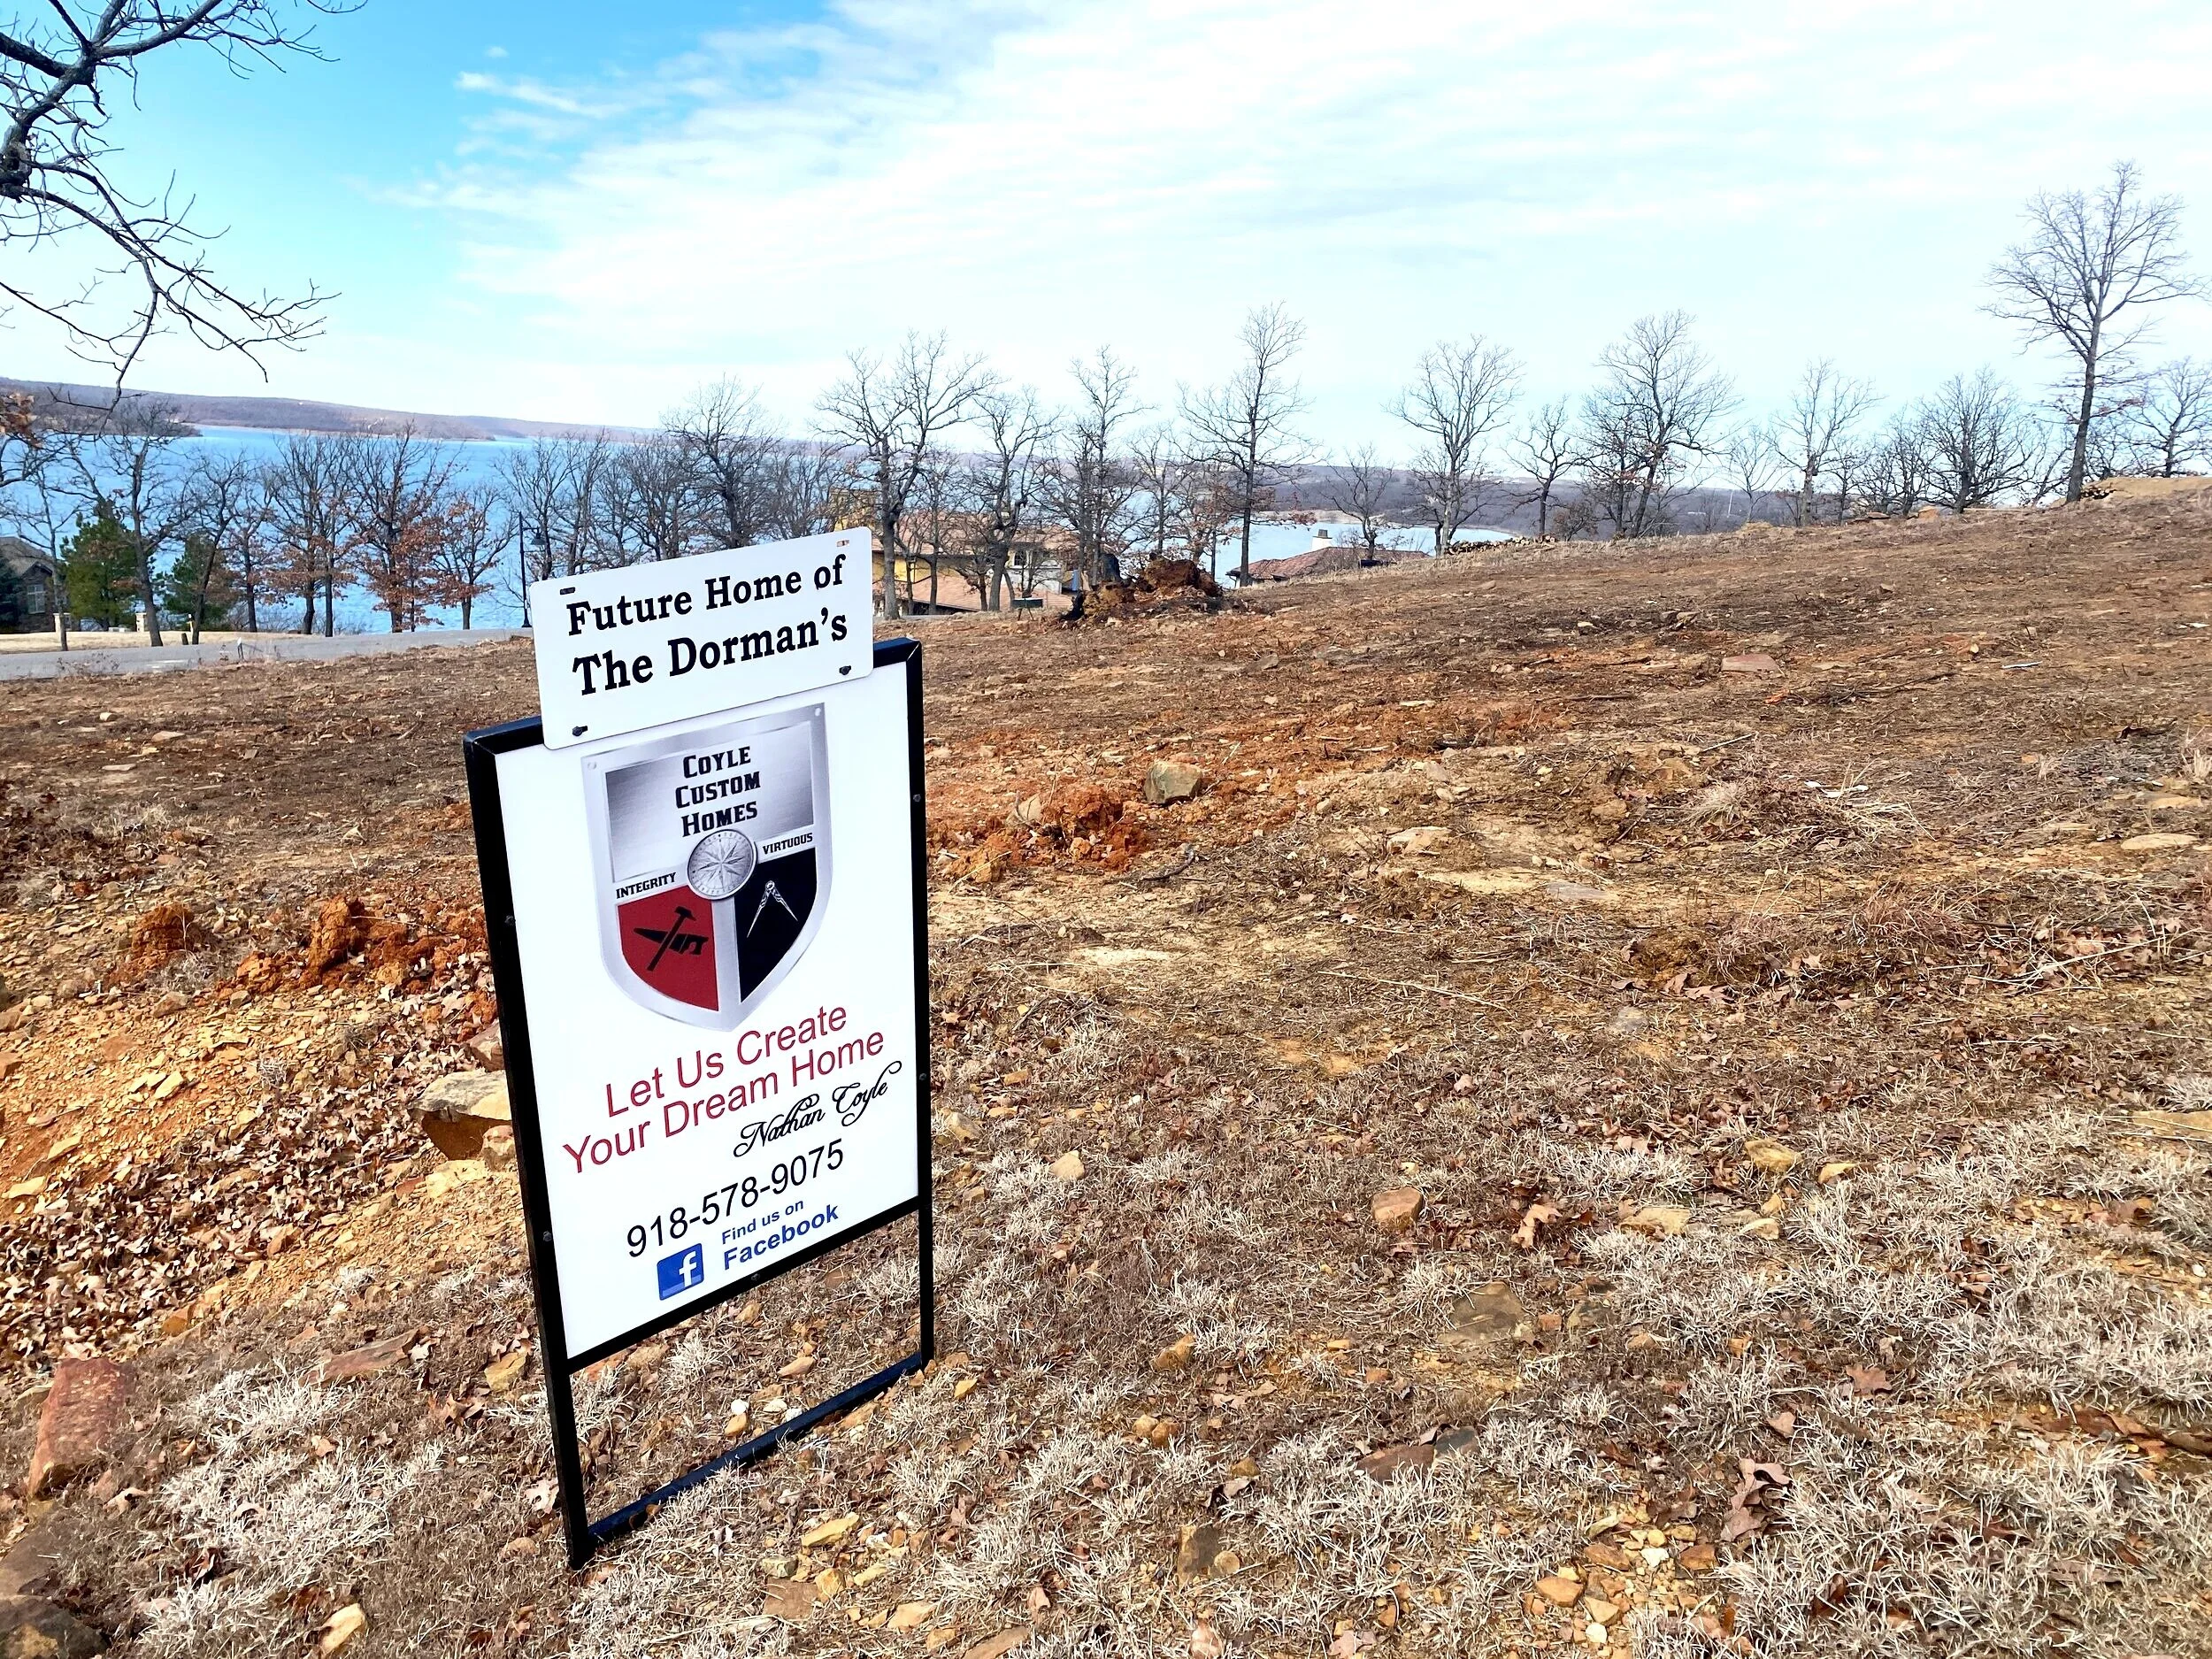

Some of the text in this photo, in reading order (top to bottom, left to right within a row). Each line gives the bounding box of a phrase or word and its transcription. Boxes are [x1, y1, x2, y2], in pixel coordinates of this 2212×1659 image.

[566, 553, 845, 635] Future Home of
[572, 649, 653, 695] The
[762, 833, 813, 854] VIRTUOUS
[615, 872, 676, 899] INTEGRITY
[605, 1005, 846, 1117] Let Us Create
[563, 1031, 884, 1173] Your Dream Home
[733, 1060, 902, 1157] Nathan Coyle
[626, 1138, 844, 1257] 918-578-9075
[721, 1200, 803, 1244] Find us on
[723, 1203, 839, 1270] Facebook
